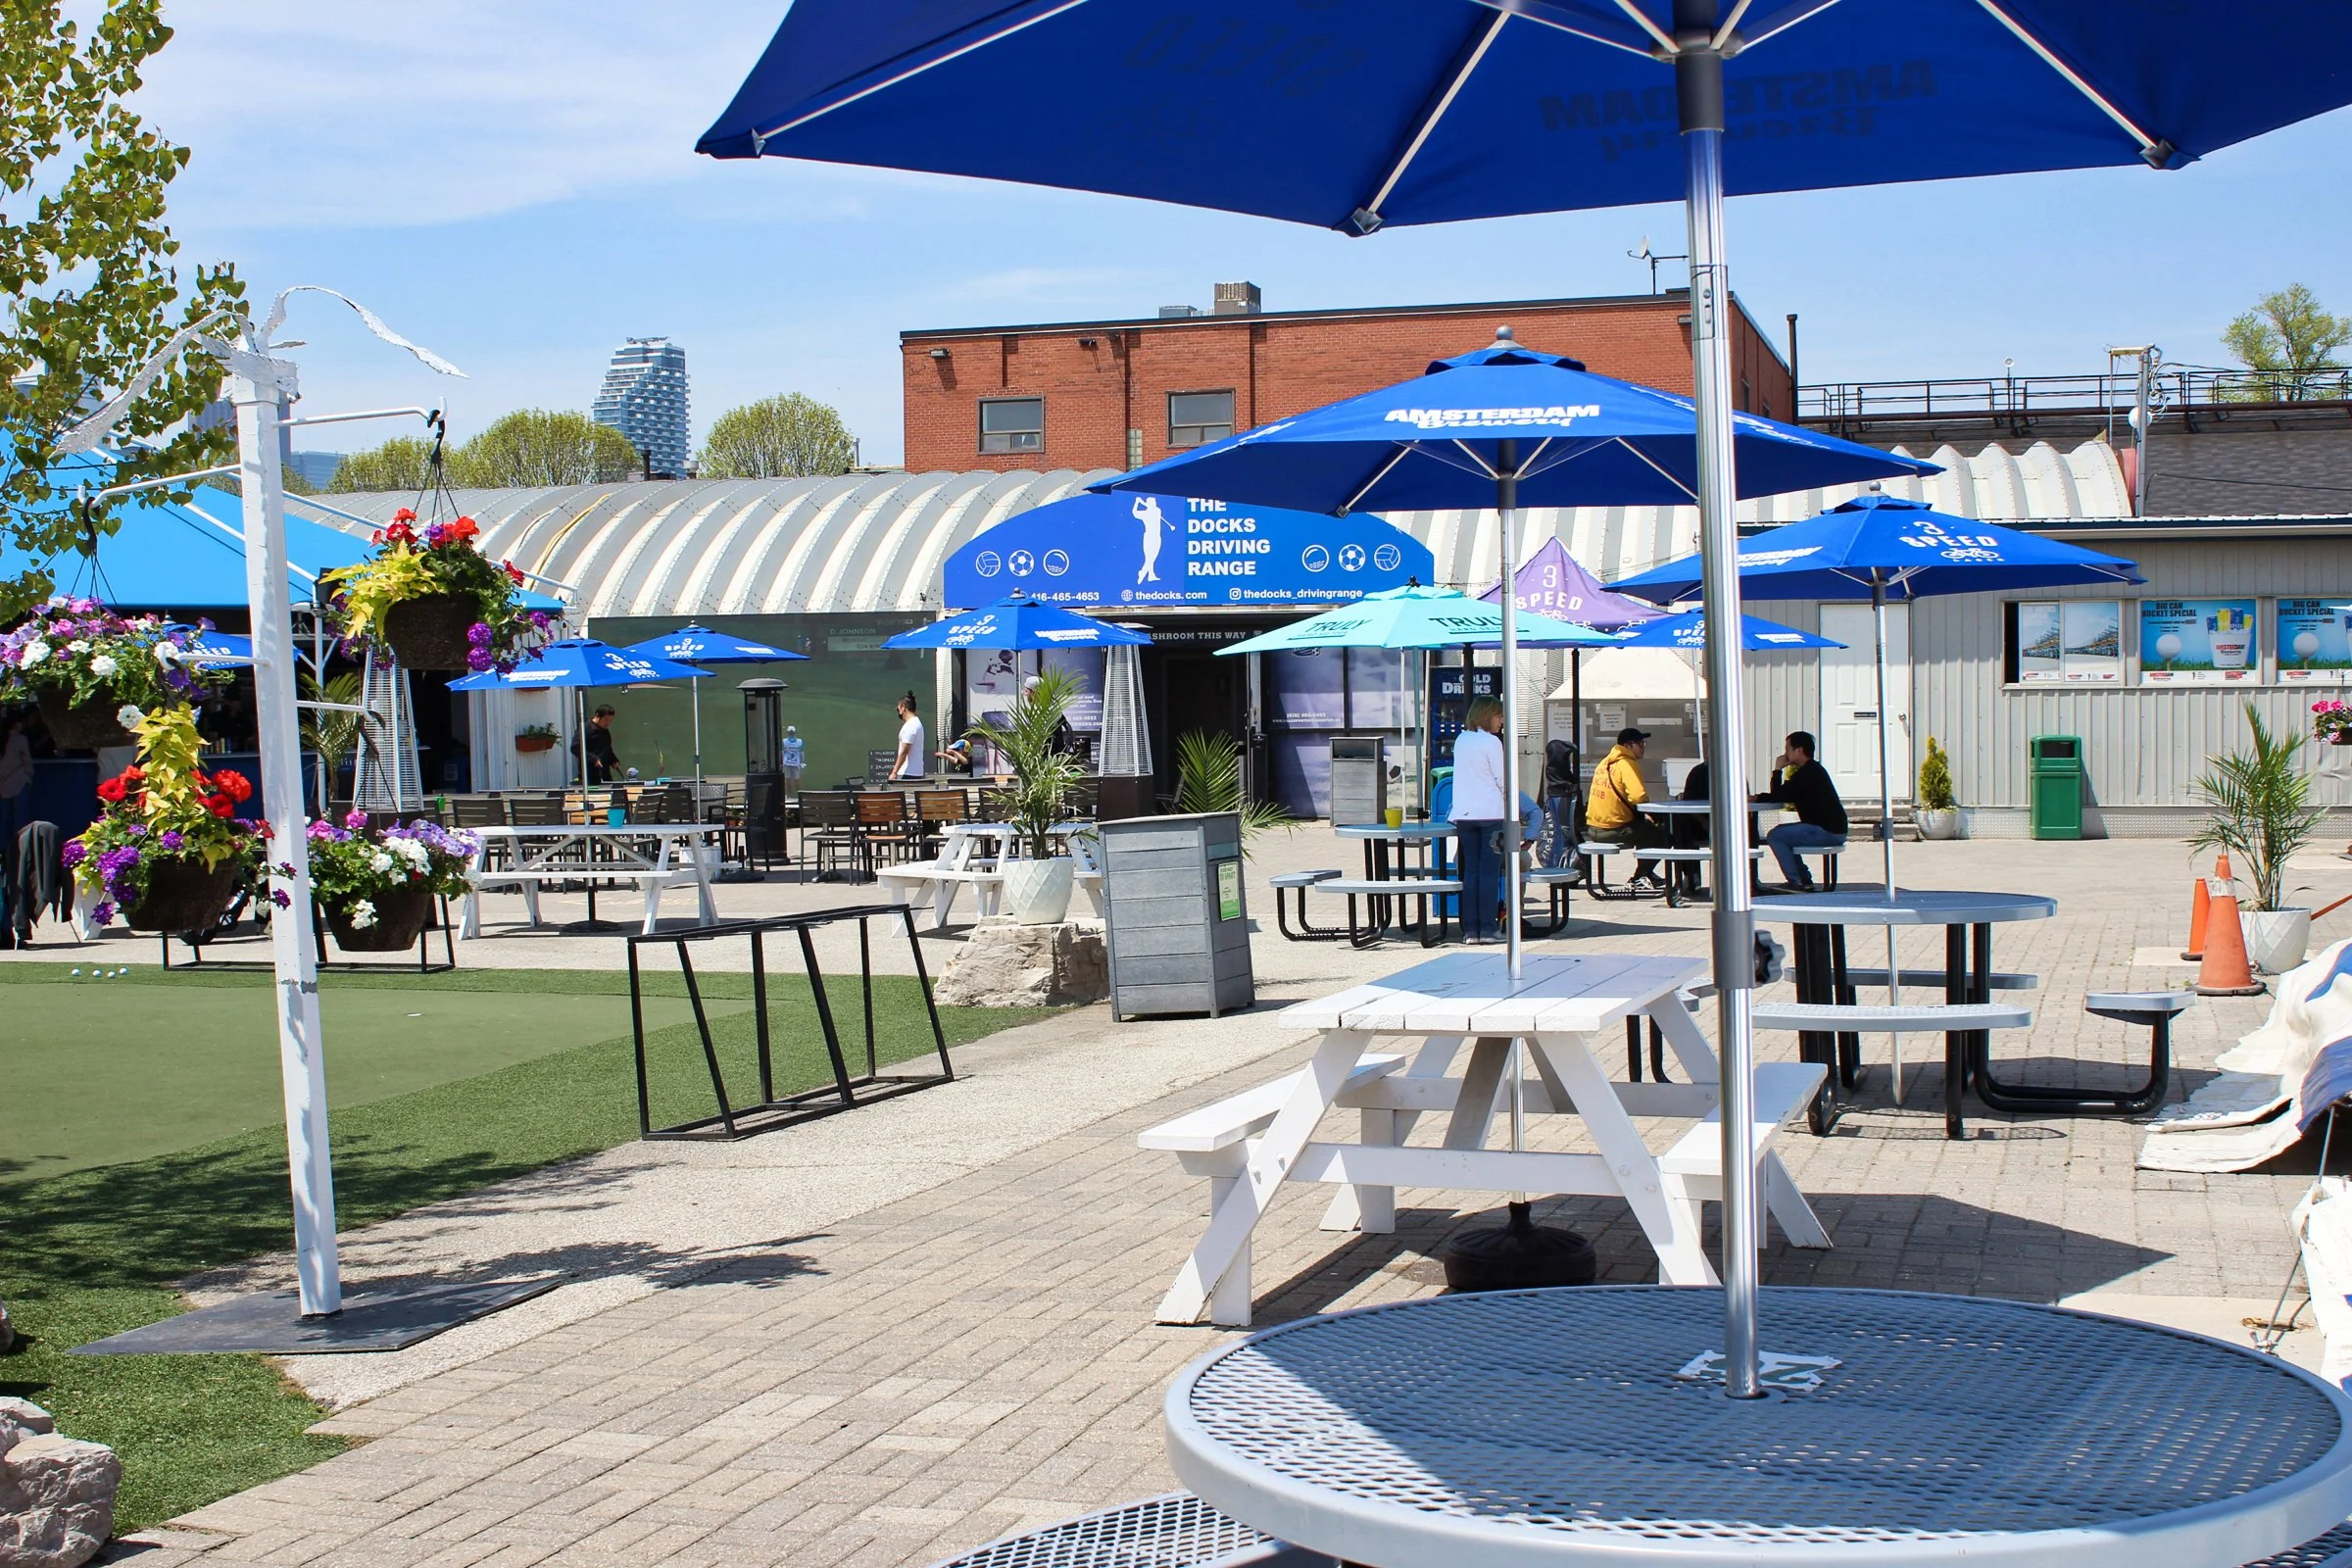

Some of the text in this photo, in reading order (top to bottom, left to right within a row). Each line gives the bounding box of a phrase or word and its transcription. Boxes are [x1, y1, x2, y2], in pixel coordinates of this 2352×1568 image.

[1384, 405, 1600, 422] AMSTERDAM
[1187, 498, 1227, 513] THE
[1188, 518, 1256, 534] DOCKS
[1188, 539, 1271, 555] DRIVING
[1898, 535, 1998, 548] SPEED
[1188, 561, 1256, 576] RANGE
[1543, 564, 1558, 588] 3
[1244, 589, 1363, 600] thedocks_drivingrange
[1515, 591, 1584, 612] SPEED
[2169, 609, 2197, 617] SPECIAL
[948, 625, 998, 635] SPEED
[1197, 631, 1222, 640] THIS
[1459, 673, 1492, 684] CLD
[1442, 681, 1492, 694] DRIKS
